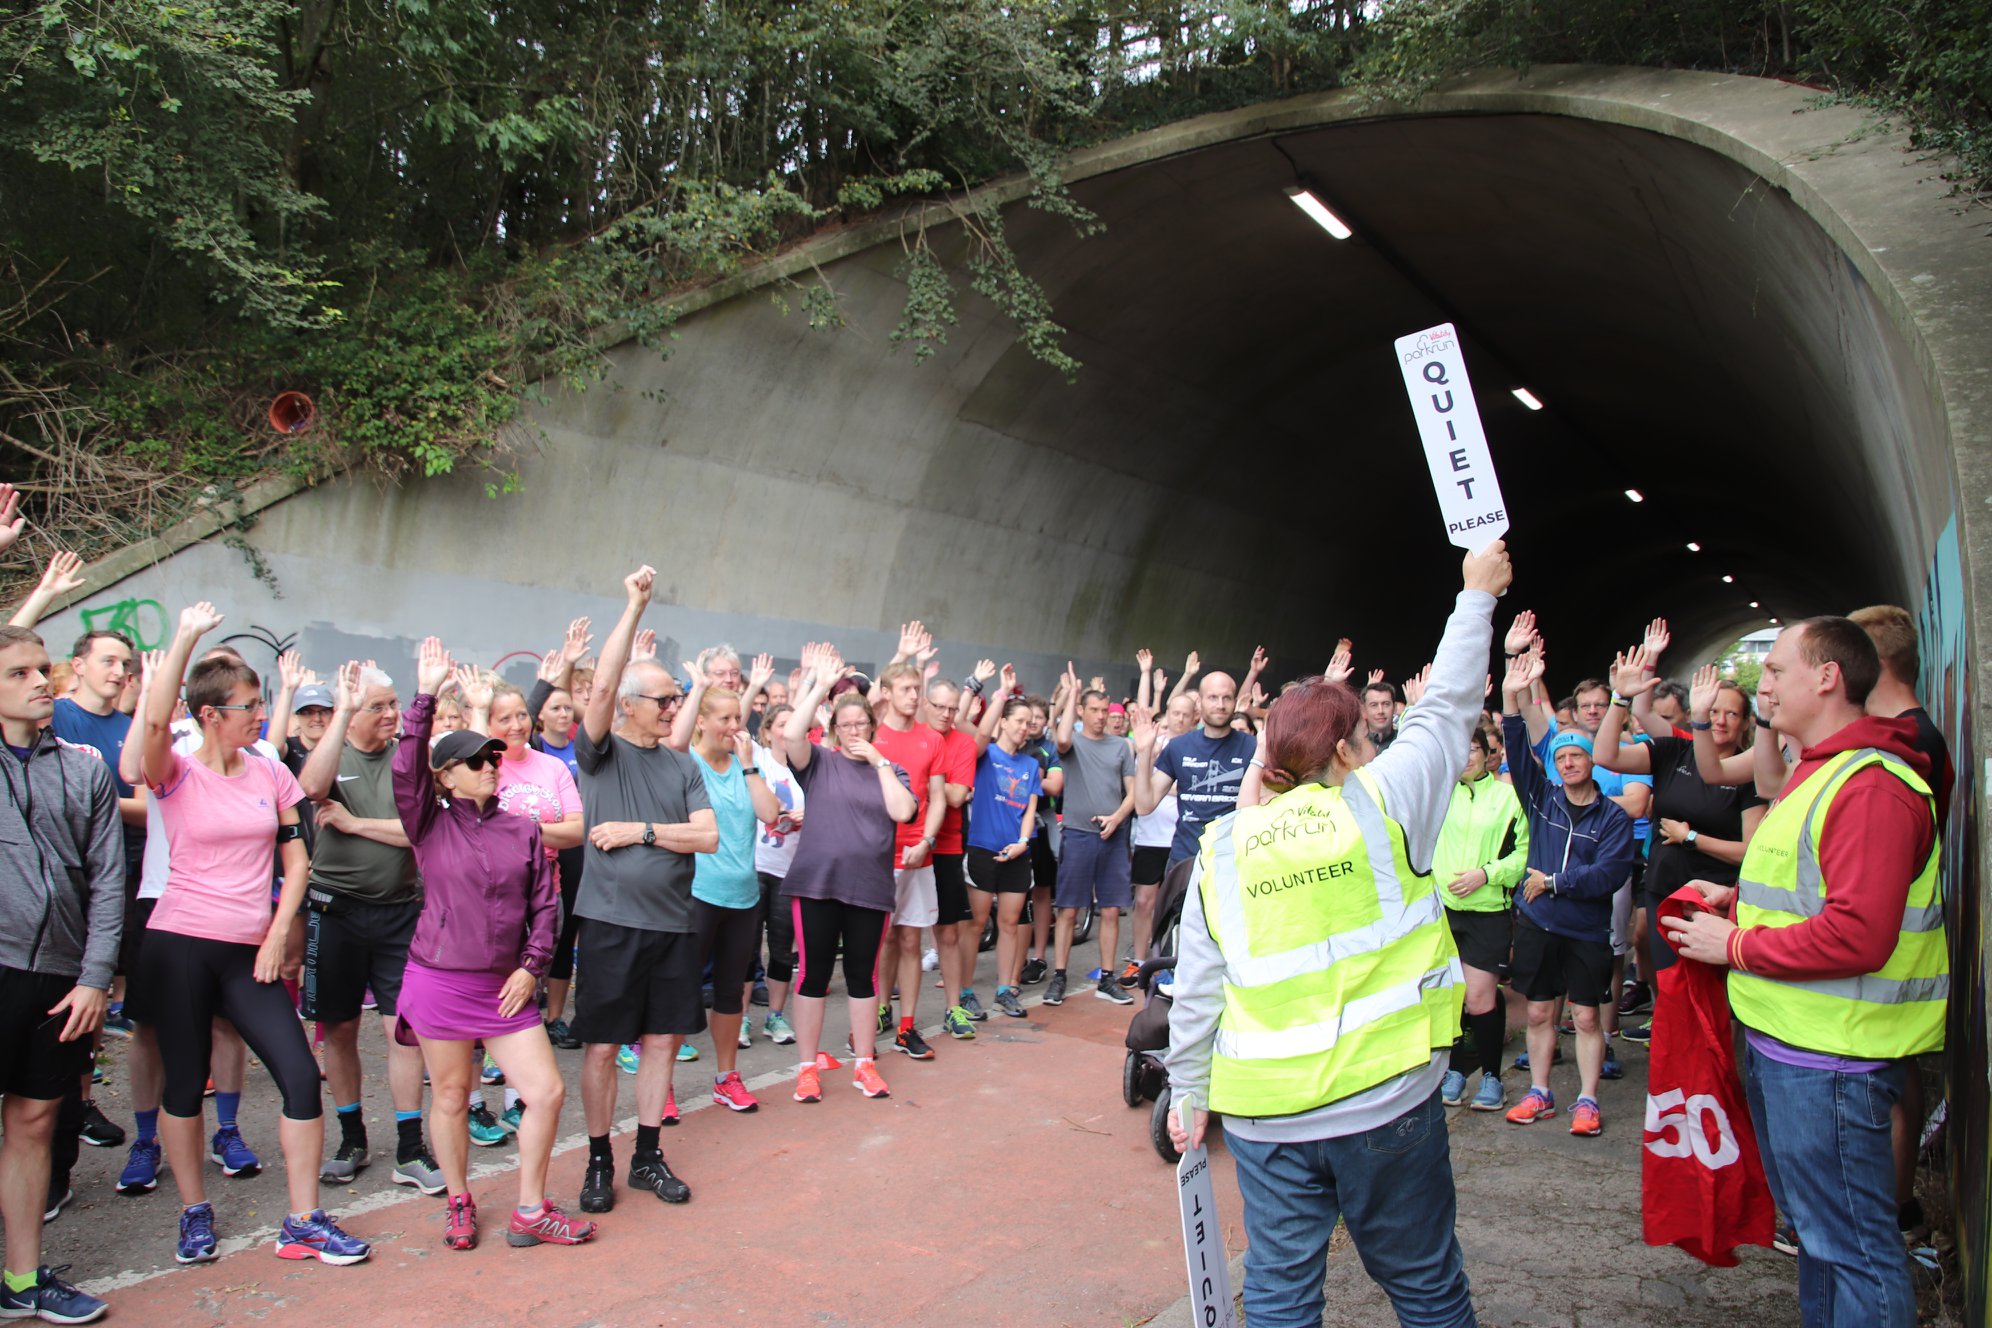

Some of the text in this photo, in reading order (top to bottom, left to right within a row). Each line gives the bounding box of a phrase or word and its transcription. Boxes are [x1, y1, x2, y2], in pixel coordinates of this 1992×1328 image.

[1404, 340, 1455, 365] parkrun
[1423, 361, 1475, 500] QUIET
[1449, 510, 1505, 534] PLEASE
[1211, 794, 1239, 802] BRIDG
[1246, 819, 1337, 857] parkrun
[1757, 844, 1789, 858] LUNTEER
[1246, 861, 1354, 899] VOLUNTEER
[1643, 1087, 1740, 1170] 50
[1181, 1157, 1207, 1187] PLEASE
[1193, 1194, 1217, 1328] QUIET
